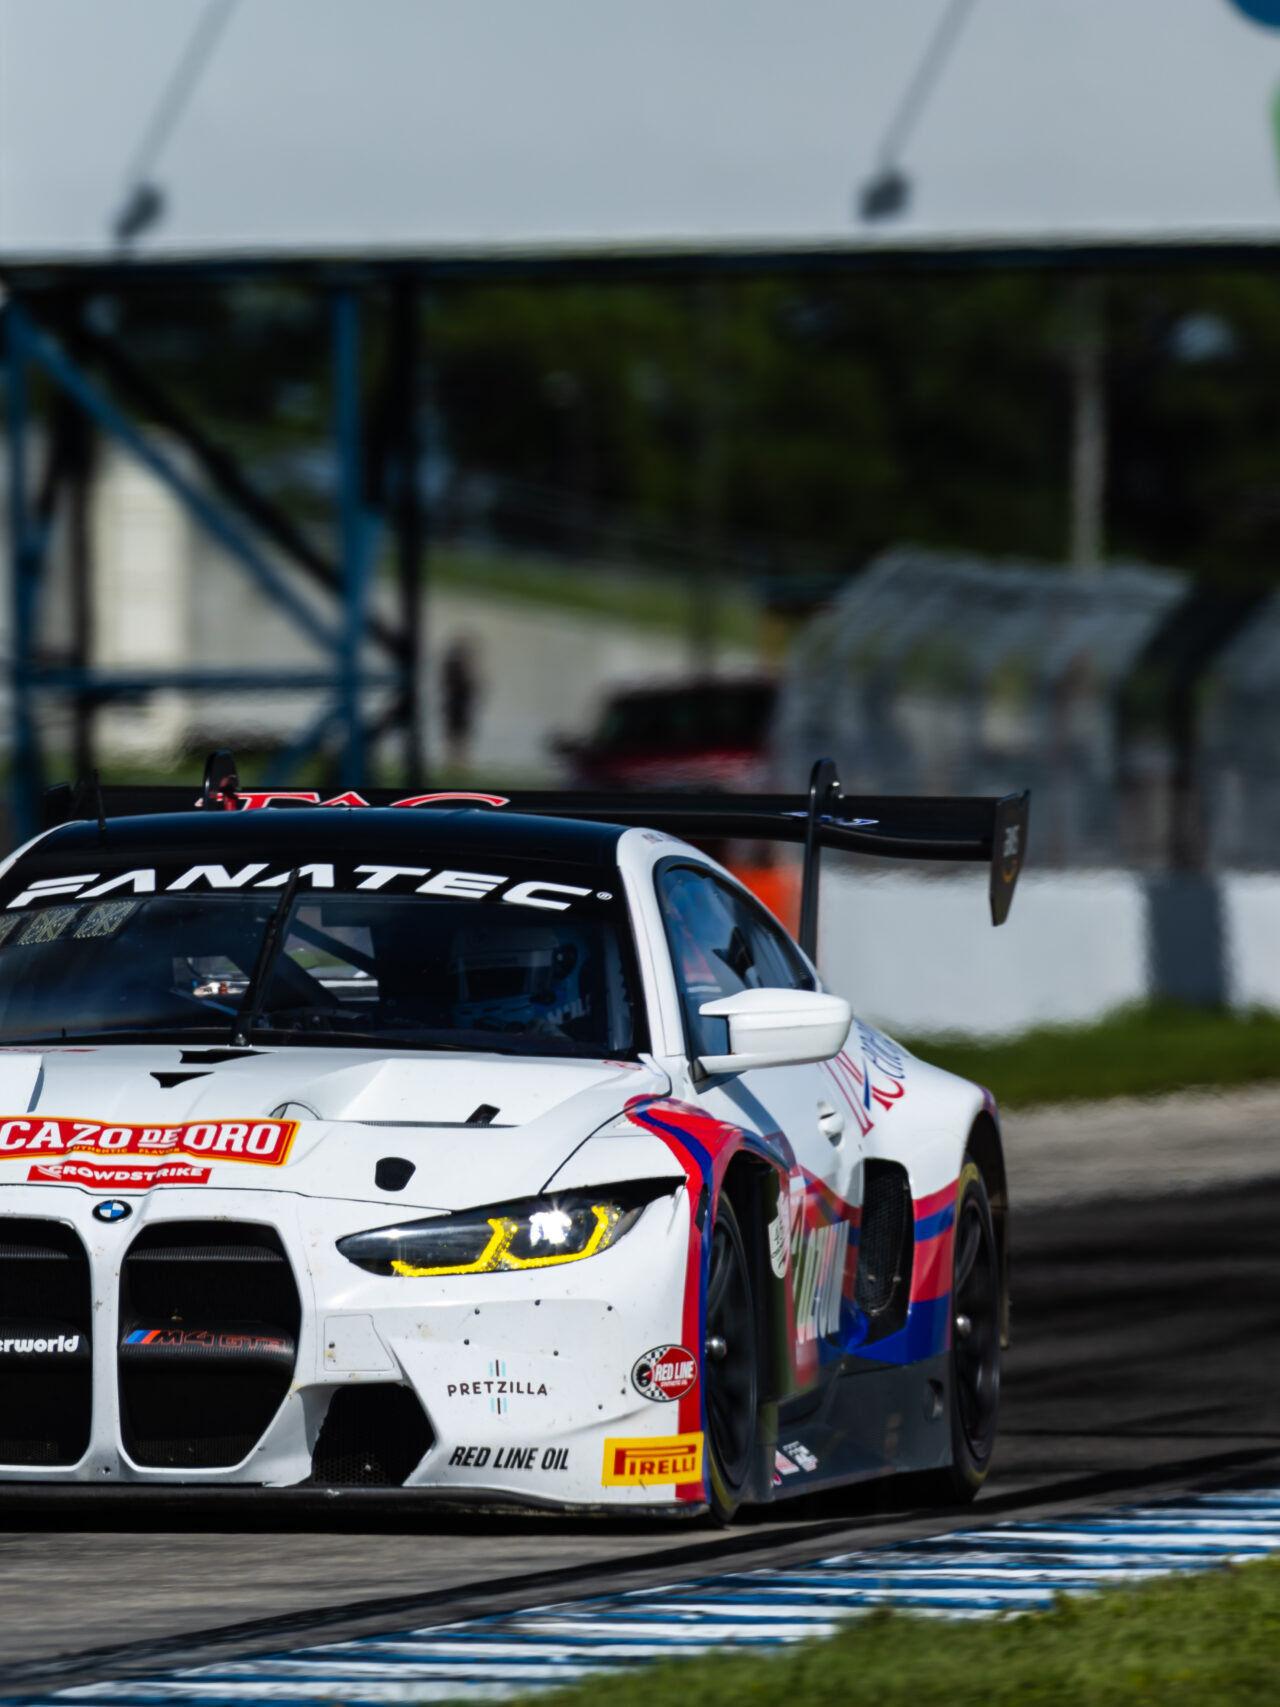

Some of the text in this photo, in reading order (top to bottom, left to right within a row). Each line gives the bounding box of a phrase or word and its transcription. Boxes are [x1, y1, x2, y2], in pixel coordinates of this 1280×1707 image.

[6, 863, 594, 911] FANATEC
[137, 1127, 183, 1148] DE
[182, 1123, 282, 1155] ORO
[47, 1164, 204, 1182] CROWDSTRIKE
[654, 1360, 695, 1382] RED LINE
[447, 1380, 548, 1397] PRETZILLA
[448, 1446, 570, 1470] RED LINE OIL
[613, 1443, 697, 1476] PIRELLI
